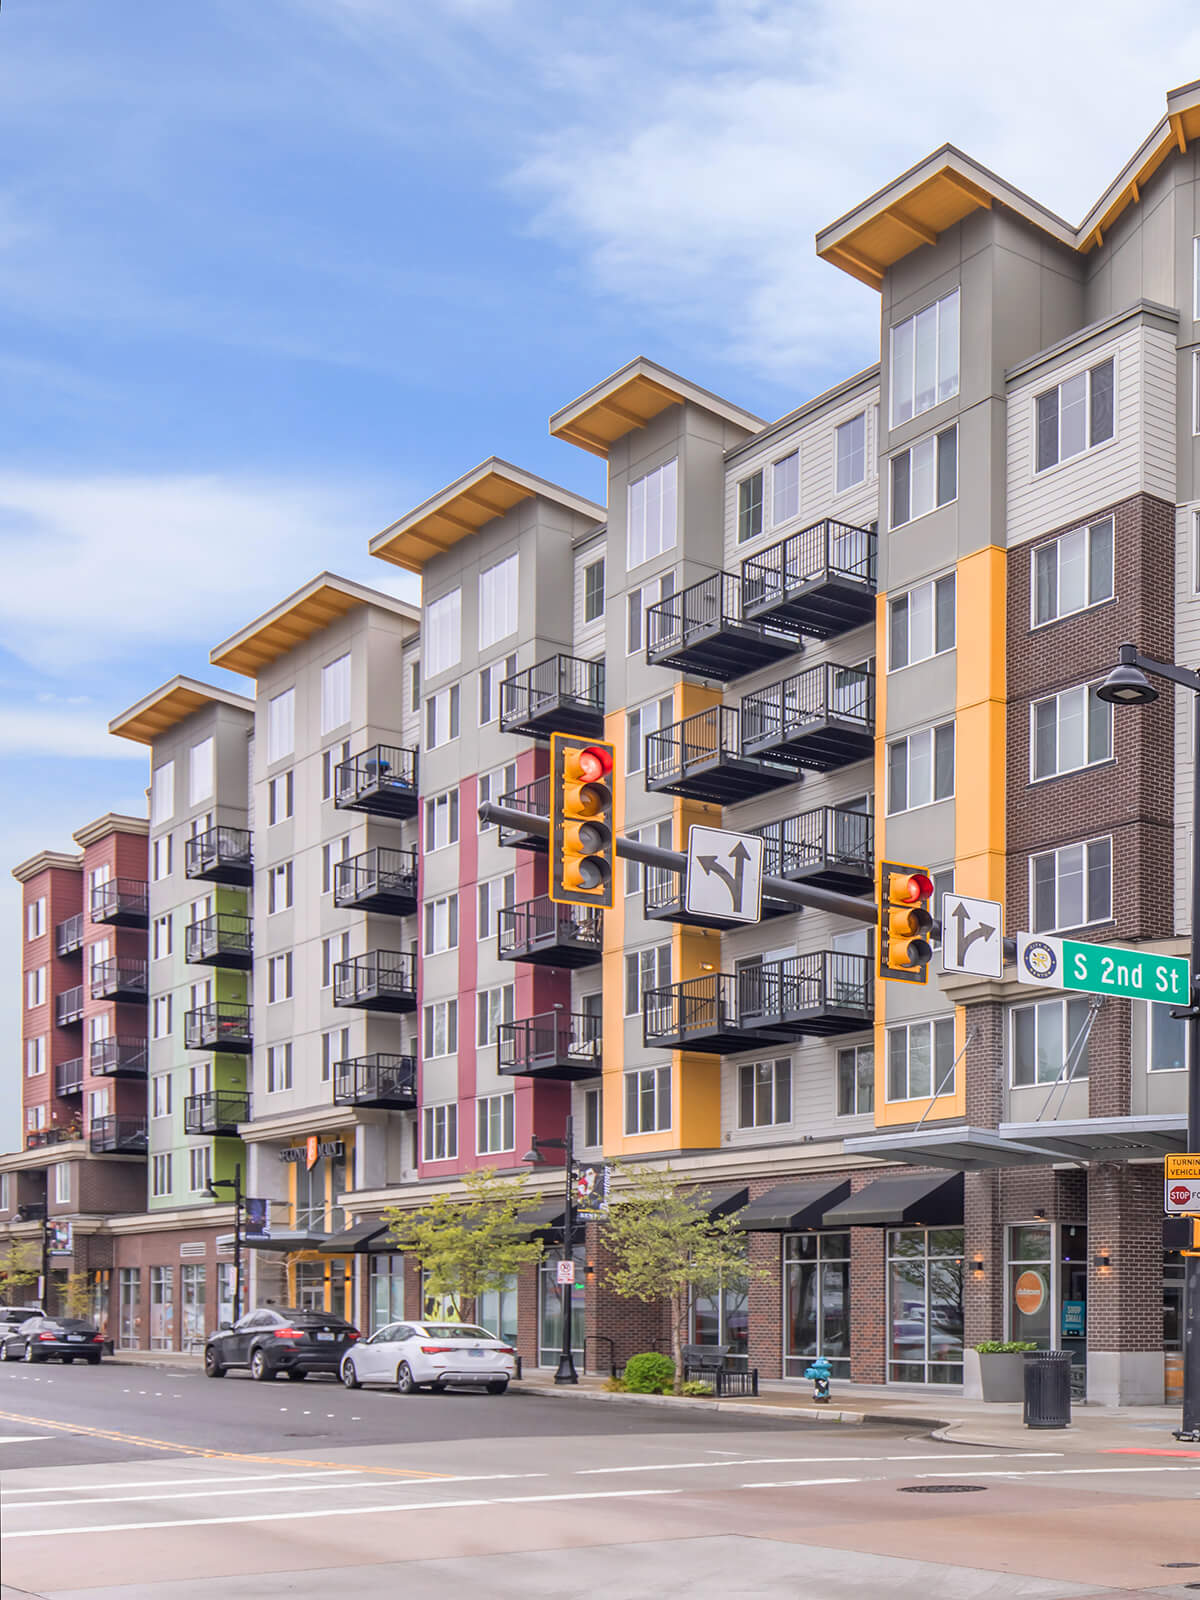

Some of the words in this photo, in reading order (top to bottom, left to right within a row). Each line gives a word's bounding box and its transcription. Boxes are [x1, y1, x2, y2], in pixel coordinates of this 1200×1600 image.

[1073, 953, 1088, 981] S
[1101, 957, 1143, 989] 2nd
[1155, 966, 1179, 994] St
[1170, 1191, 1190, 1200] STOP
